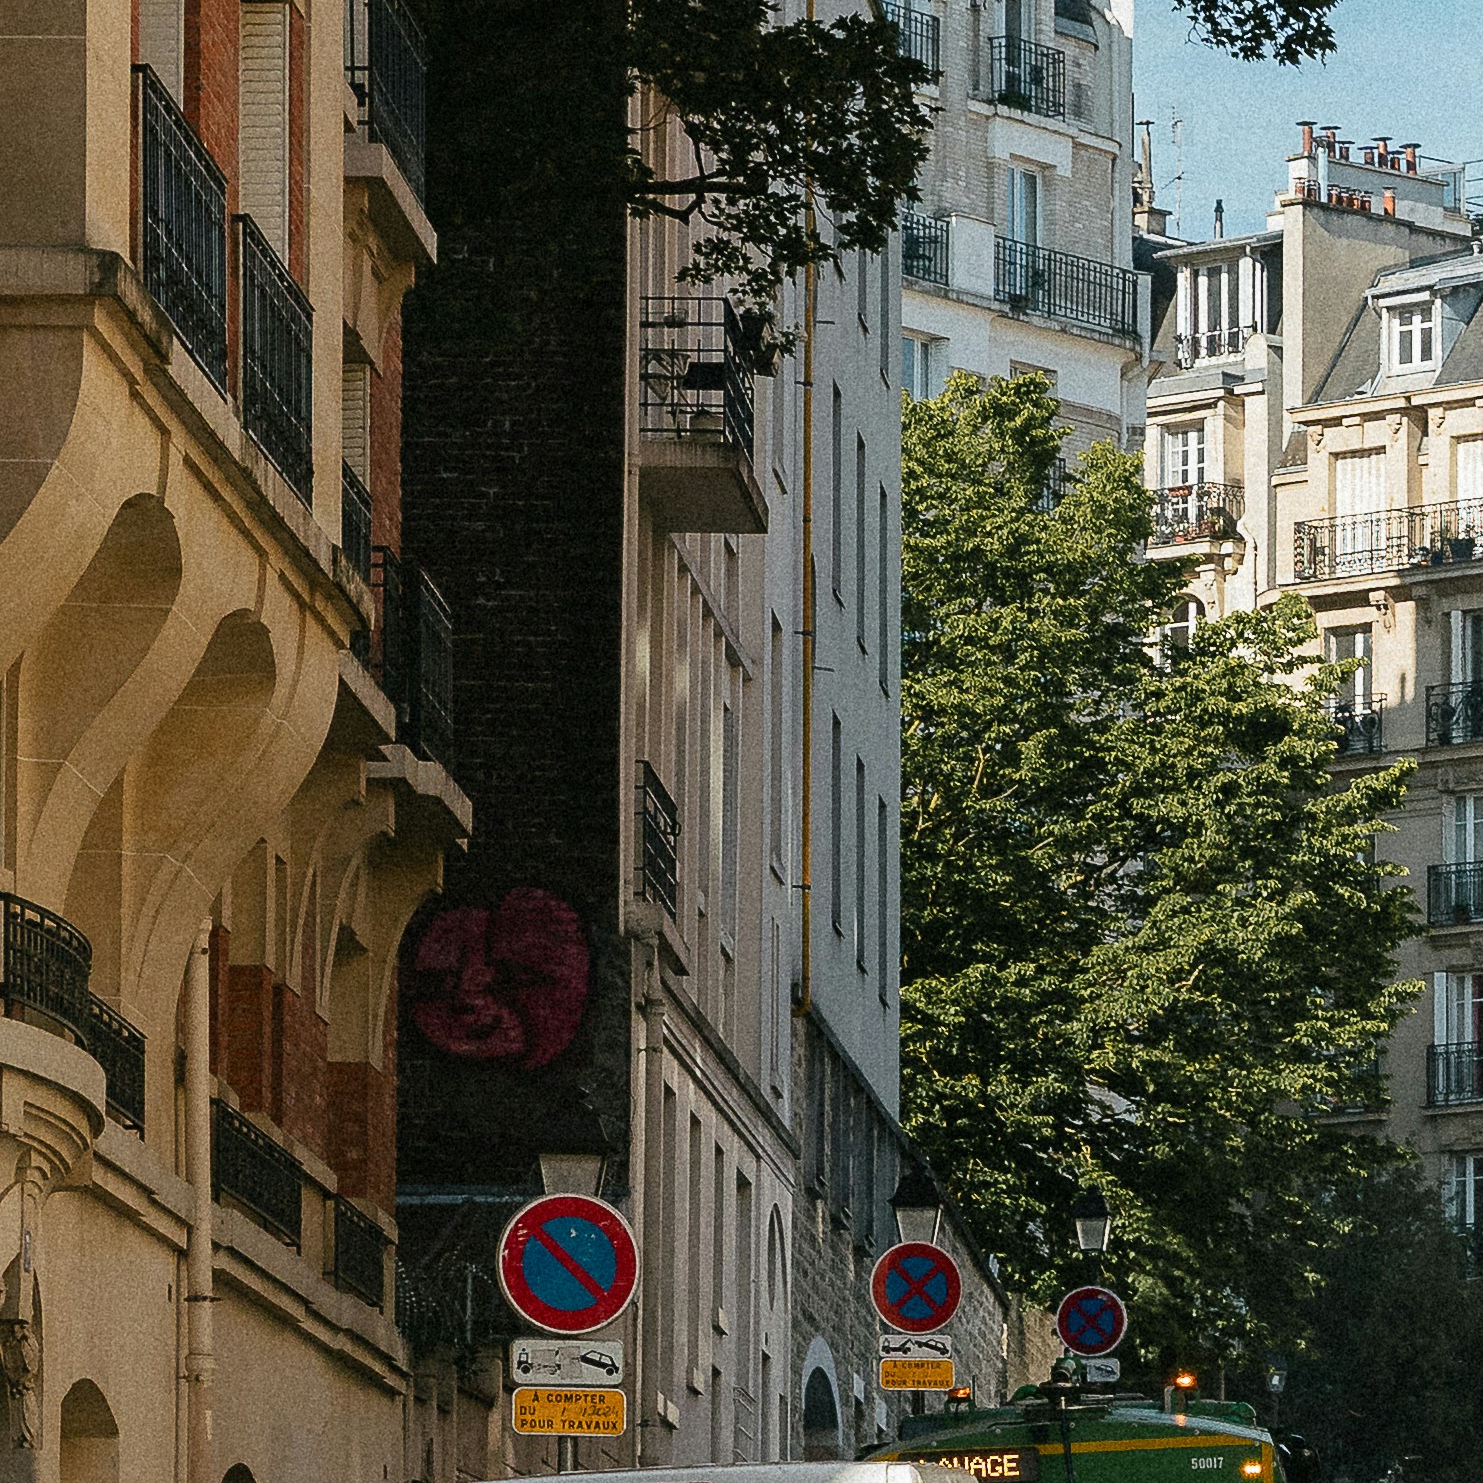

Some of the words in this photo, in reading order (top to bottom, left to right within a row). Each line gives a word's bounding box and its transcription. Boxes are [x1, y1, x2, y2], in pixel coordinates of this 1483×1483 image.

[532, 1391, 540, 1403] À
[546, 1393, 606, 1405] COMPTER
[519, 1405, 536, 1416] DU
[520, 1418, 554, 1429] POUR
[561, 1419, 619, 1431] TRAVAUX
[1191, 1457, 1224, 1469] 50017
